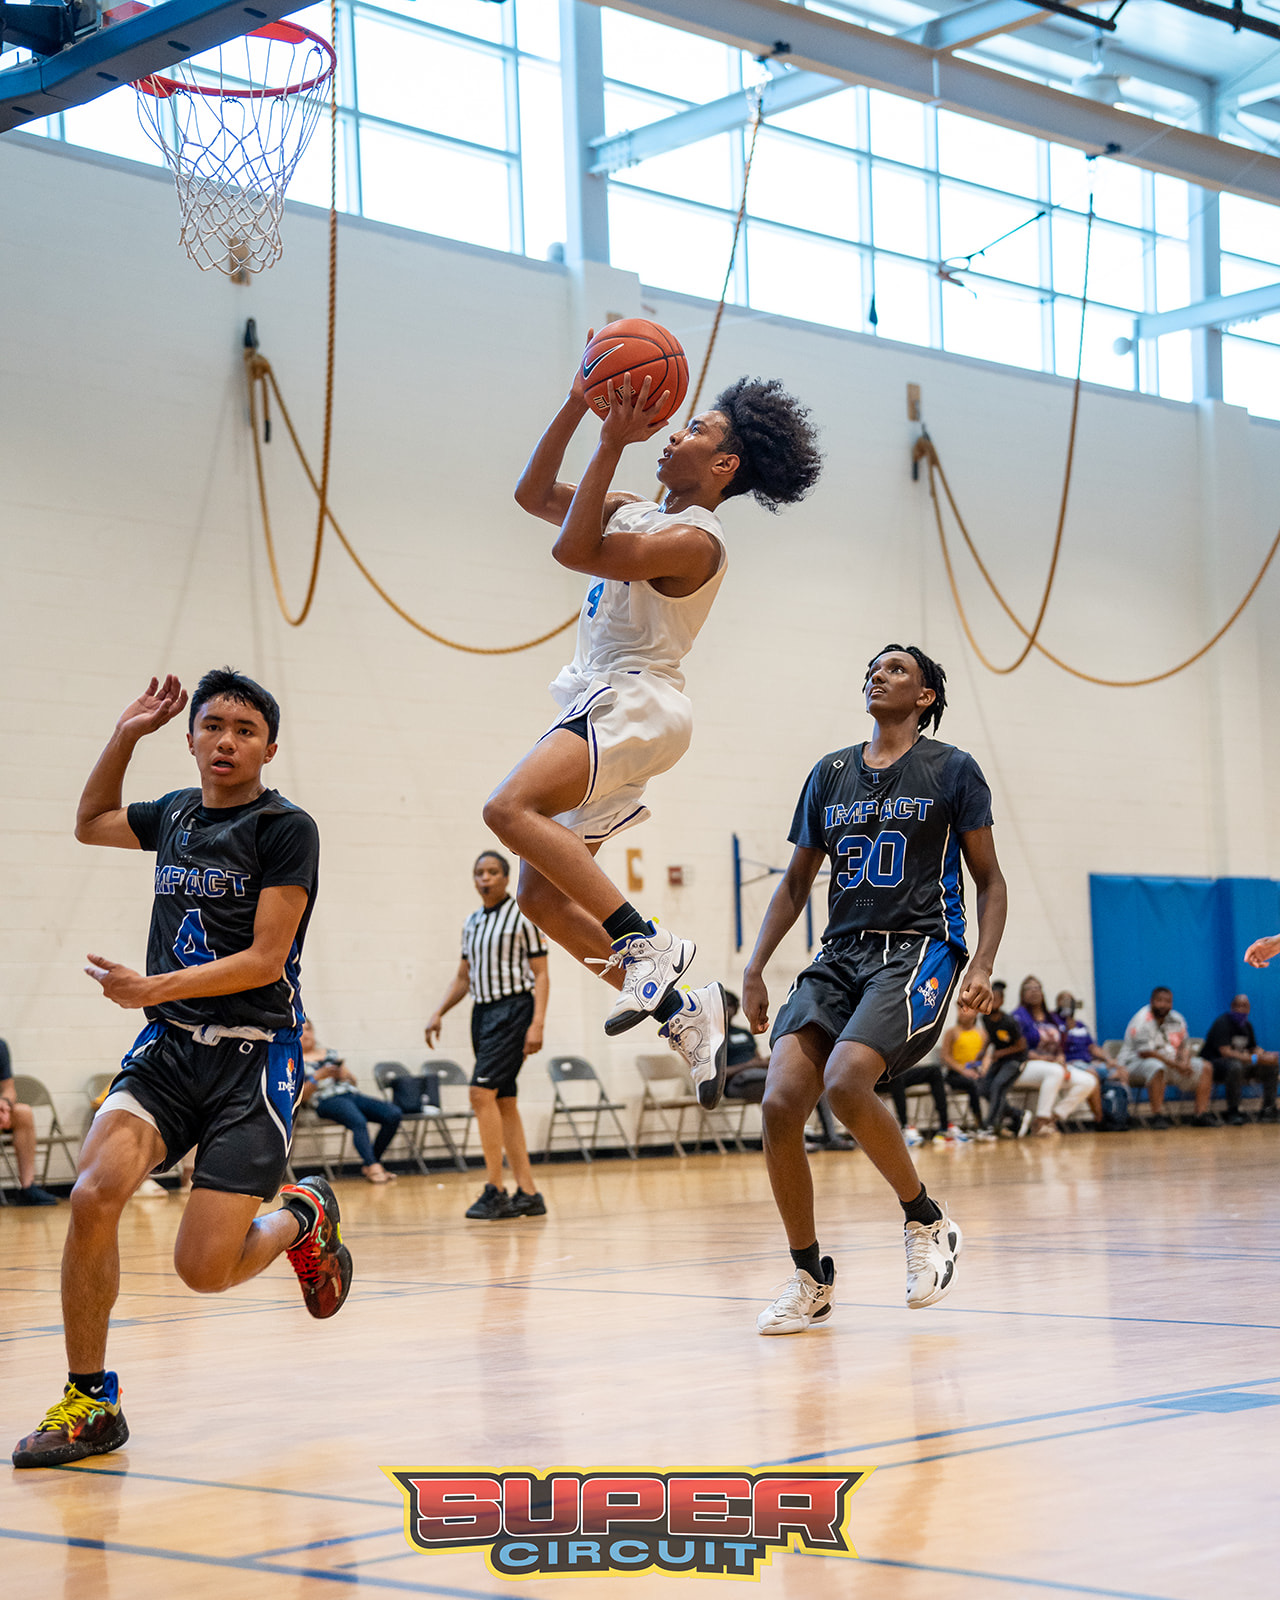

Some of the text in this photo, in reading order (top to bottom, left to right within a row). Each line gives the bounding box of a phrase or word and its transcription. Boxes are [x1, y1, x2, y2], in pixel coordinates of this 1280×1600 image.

[824, 796, 934, 830] IMPACT
[155, 865, 251, 898] MPACT
[836, 830, 908, 891] 30
[172, 908, 217, 968] 4
